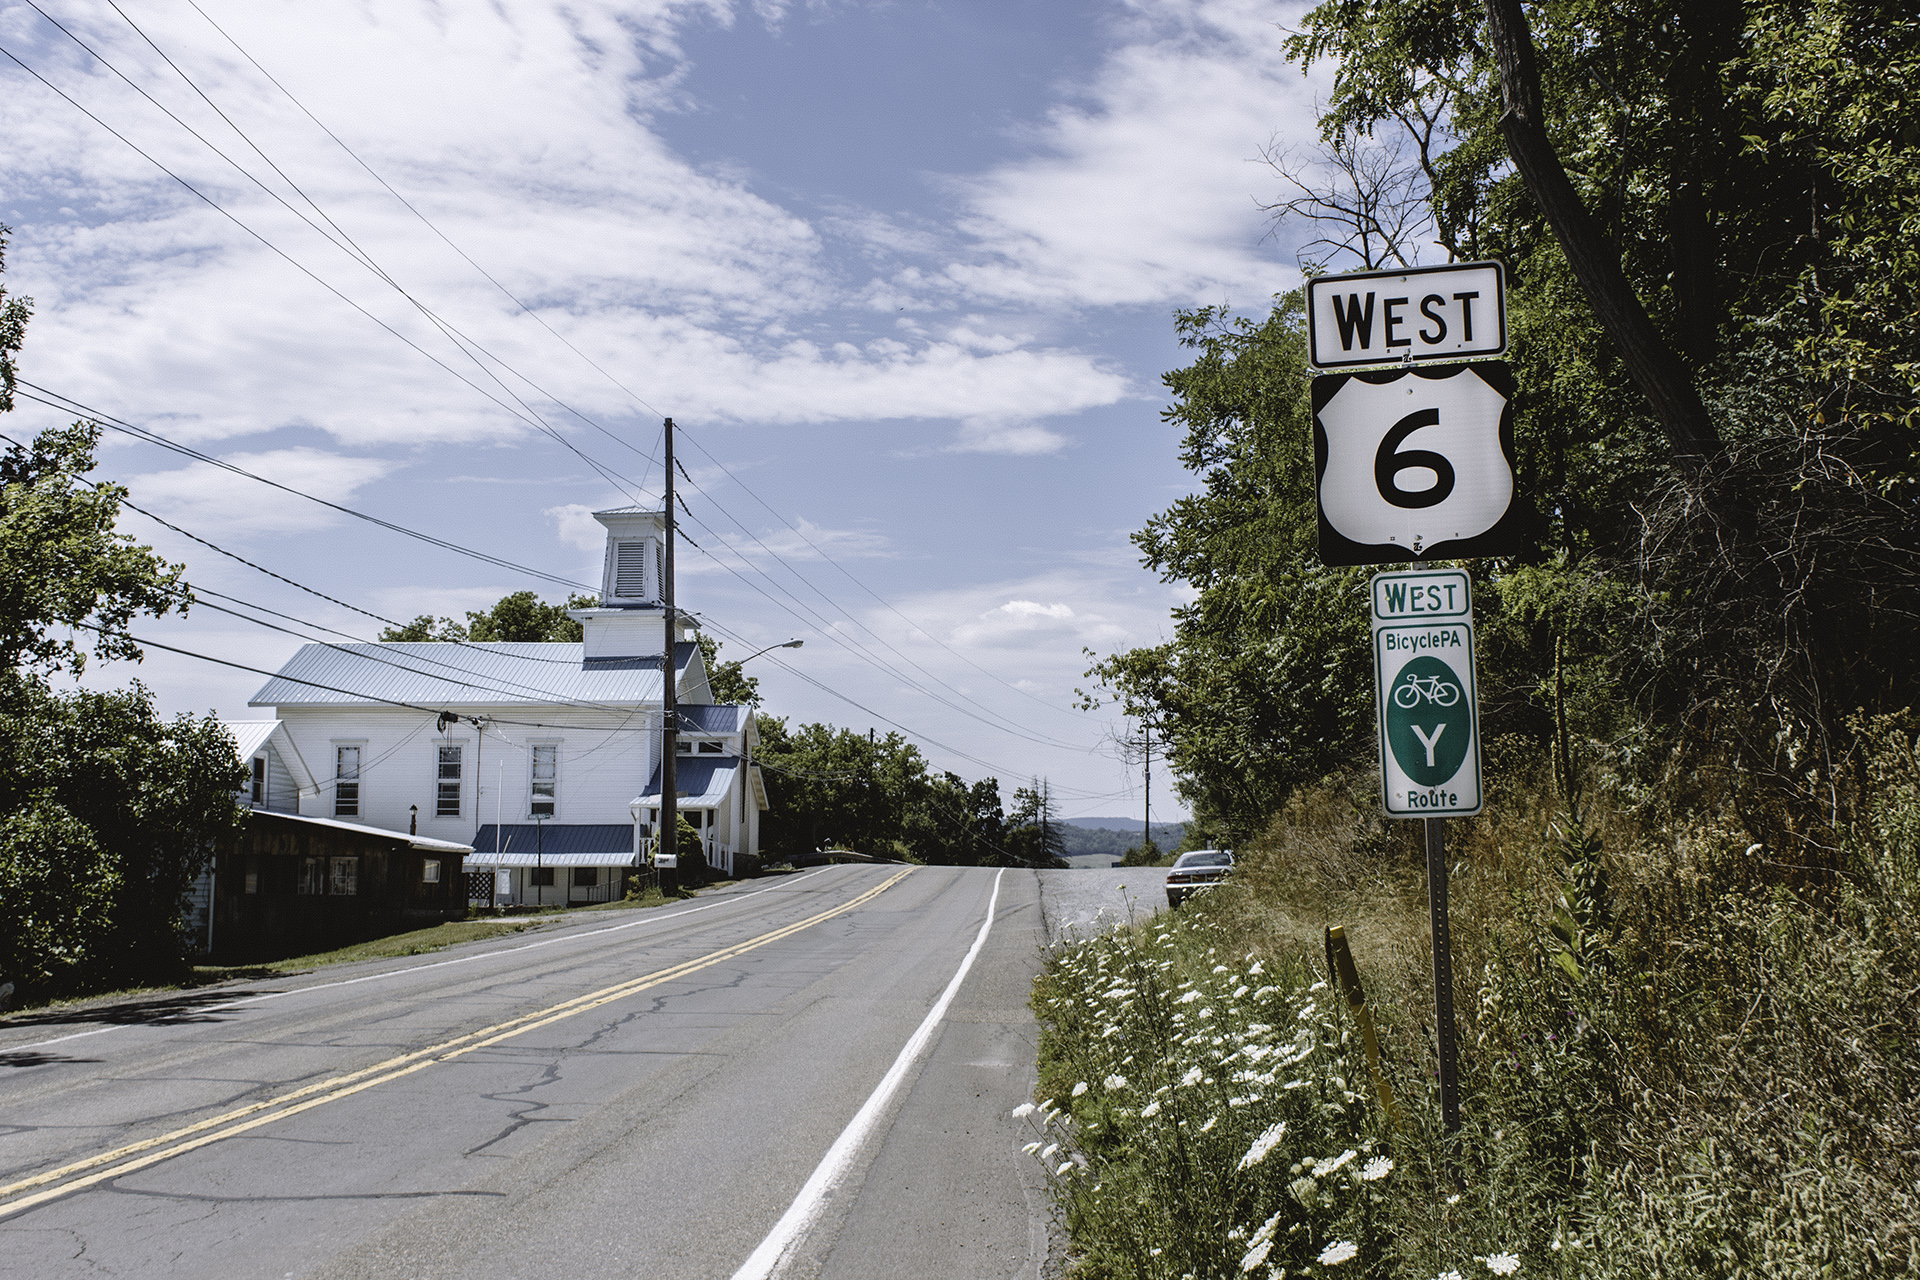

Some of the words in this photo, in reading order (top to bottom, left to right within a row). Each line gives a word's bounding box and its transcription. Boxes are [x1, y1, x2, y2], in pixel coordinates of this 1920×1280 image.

[1331, 291, 1480, 351] WEST
[1374, 407, 1456, 510] 6
[1384, 582, 1457, 614] WEST
[1386, 630, 1462, 654] BicyclePA
[1410, 723, 1447, 767] Y
[1407, 790, 1459, 809] Route
